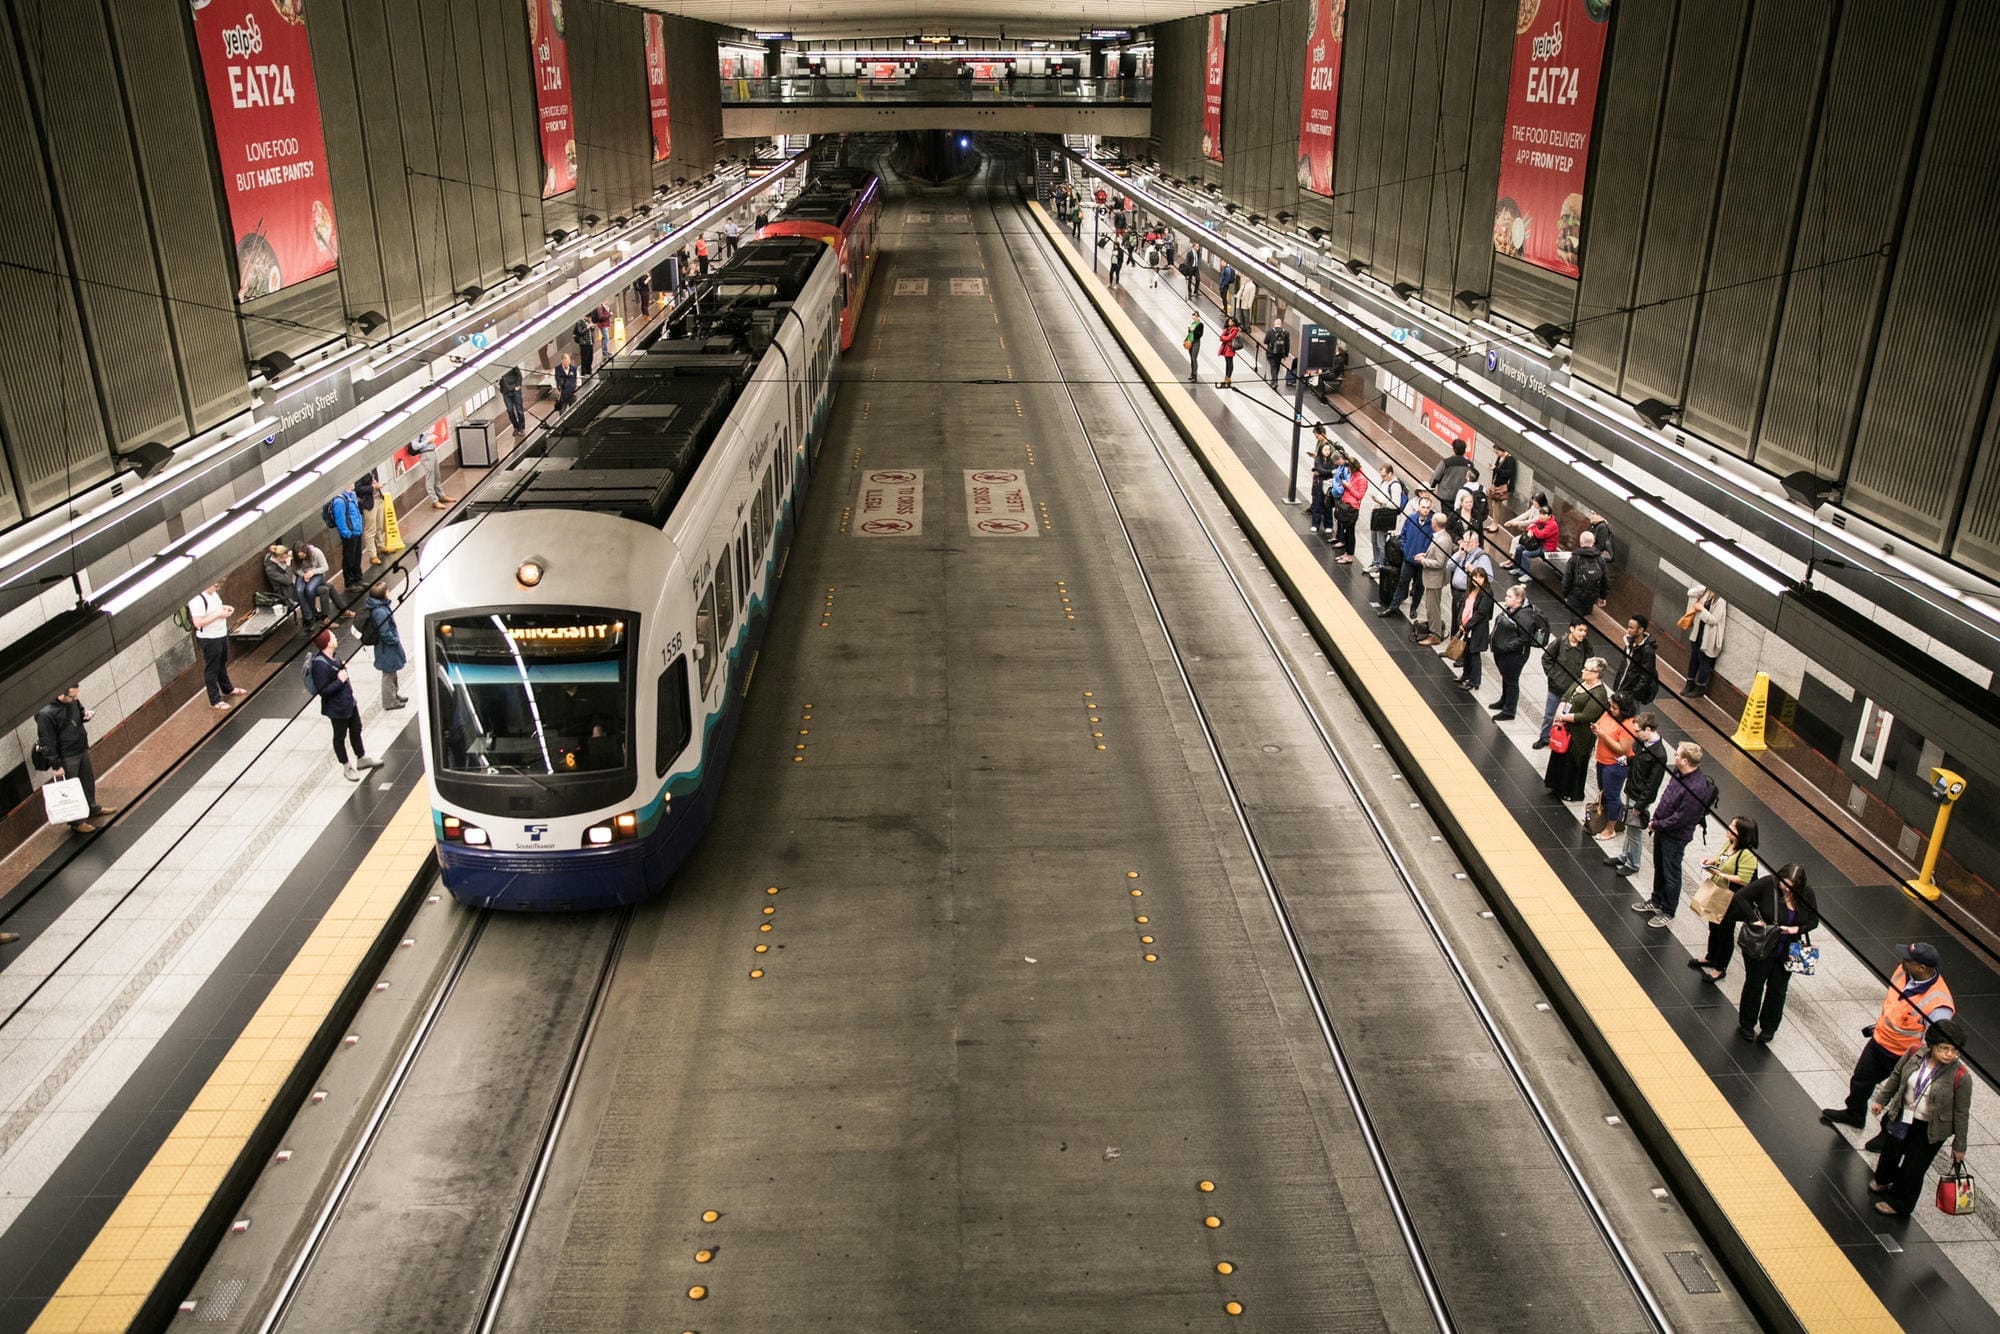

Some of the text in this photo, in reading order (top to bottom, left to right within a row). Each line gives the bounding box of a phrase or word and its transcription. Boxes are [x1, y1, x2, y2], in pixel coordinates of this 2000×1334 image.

[222, 24, 251, 59] yelp
[1532, 32, 1553, 62] yelp
[227, 64, 295, 109] EAT24
[1310, 67, 1333, 91] EAT24
[1526, 66, 1580, 105] EAT24
[245, 137, 299, 162] LOVE FOOD
[1512, 125, 1586, 150] THE FOOD DELIVERY
[1516, 149, 1574, 173] APP FROM YELP
[236, 160, 314, 192] BUT HATE PANTS?
[1498, 358, 1547, 396] University Stree
[280, 388, 338, 432] University Street
[864, 489, 883, 513] ILLEGAL
[896, 487, 915, 515] TO CROSS
[973, 487, 992, 515] TO CROSS
[1005, 489, 1025, 513] ILLEGAL
[662, 631, 682, 666] 155B
